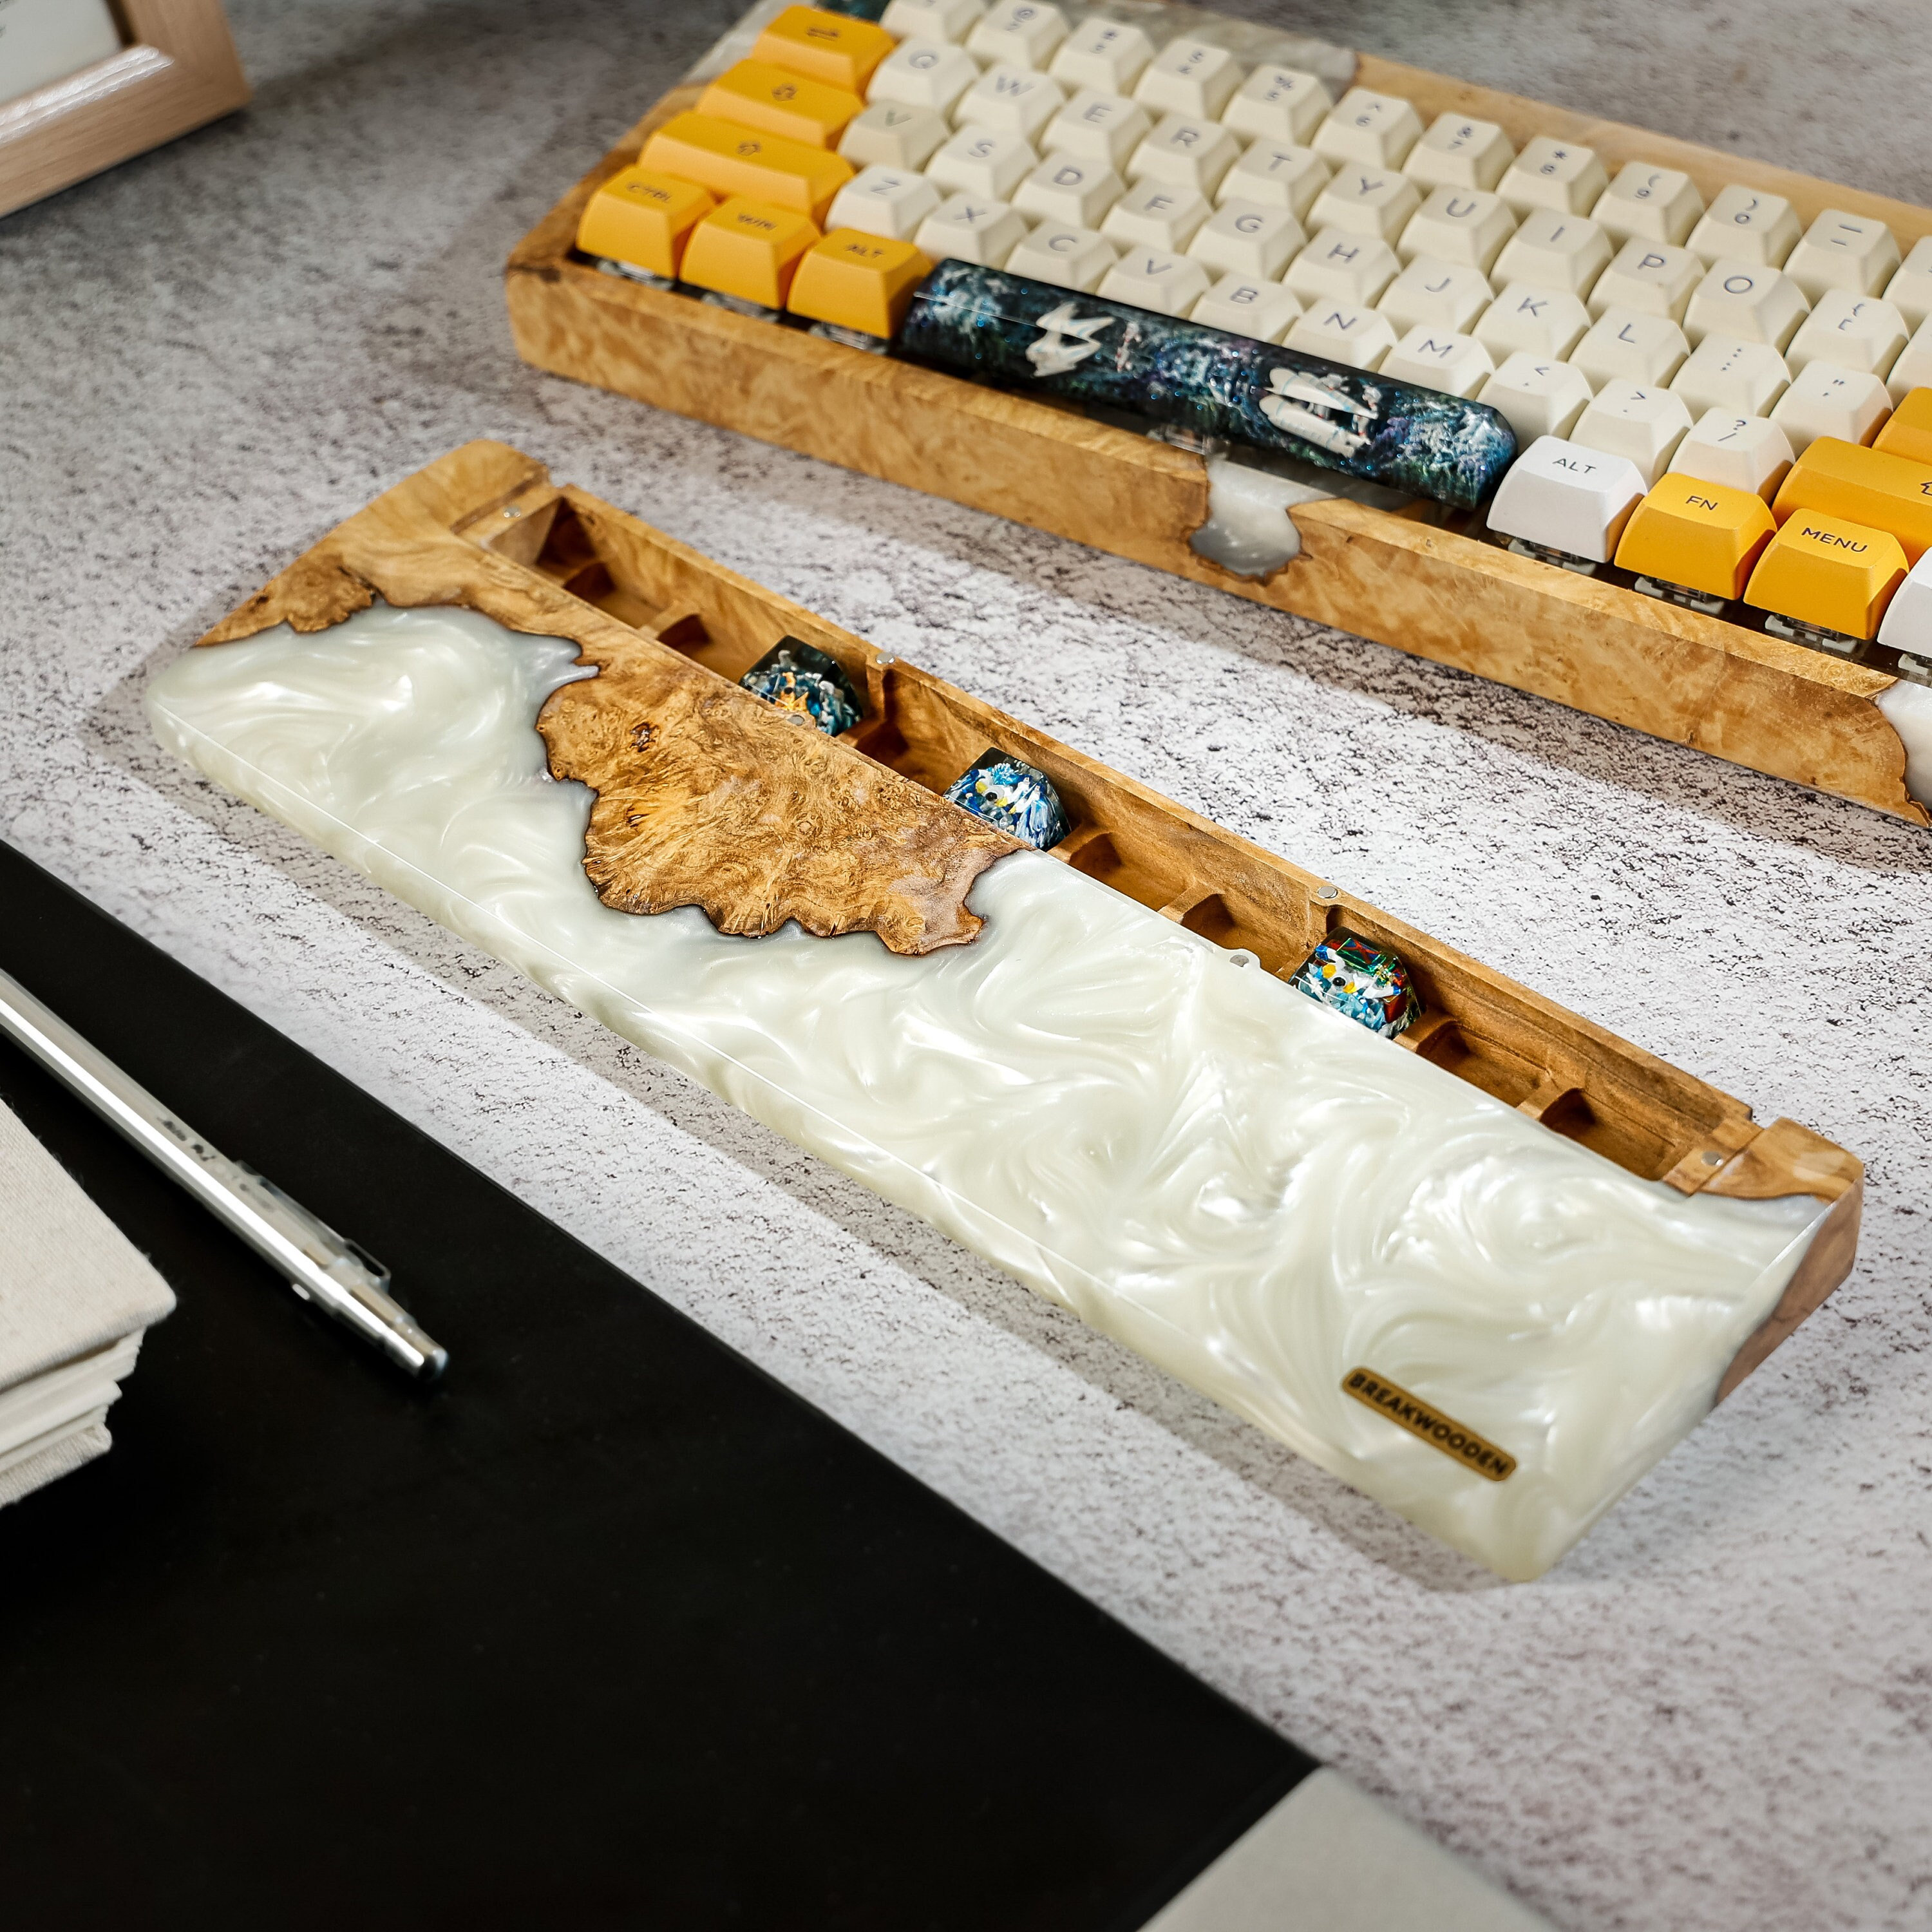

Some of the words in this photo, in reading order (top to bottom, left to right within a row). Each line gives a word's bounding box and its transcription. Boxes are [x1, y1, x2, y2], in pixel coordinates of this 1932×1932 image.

[995, 73, 1036, 97] W
[1082, 103, 1112, 124] E
[1171, 128, 1200, 147] R
[967, 138, 996, 158] S
[1269, 151, 1294, 172] T
[1053, 167, 1084, 186] D
[1358, 176, 1386, 196] Y
[870, 177, 901, 196] Z
[1142, 194, 1173, 212] F
[1444, 197, 1477, 218] U
[953, 205, 988, 224] X
[1234, 215, 1263, 233] G
[1047, 234, 1078, 252] C
[1328, 243, 1359, 263] H
[1638, 253, 1666, 269] P
[1145, 258, 1172, 276] V
[1424, 277, 1452, 293] J
[1723, 276, 1754, 294] O
[1229, 287, 1259, 304] B
[1517, 296, 1548, 317] K
[1325, 312, 1356, 330] N
[1617, 323, 1636, 344] L
[1419, 339, 1454, 357] M
[1553, 457, 1596, 474] ALT
[1685, 495, 1719, 511] FN
[1801, 526, 1868, 553] MENU
[1349, 1373, 1508, 1475] BREAKWOODEN
